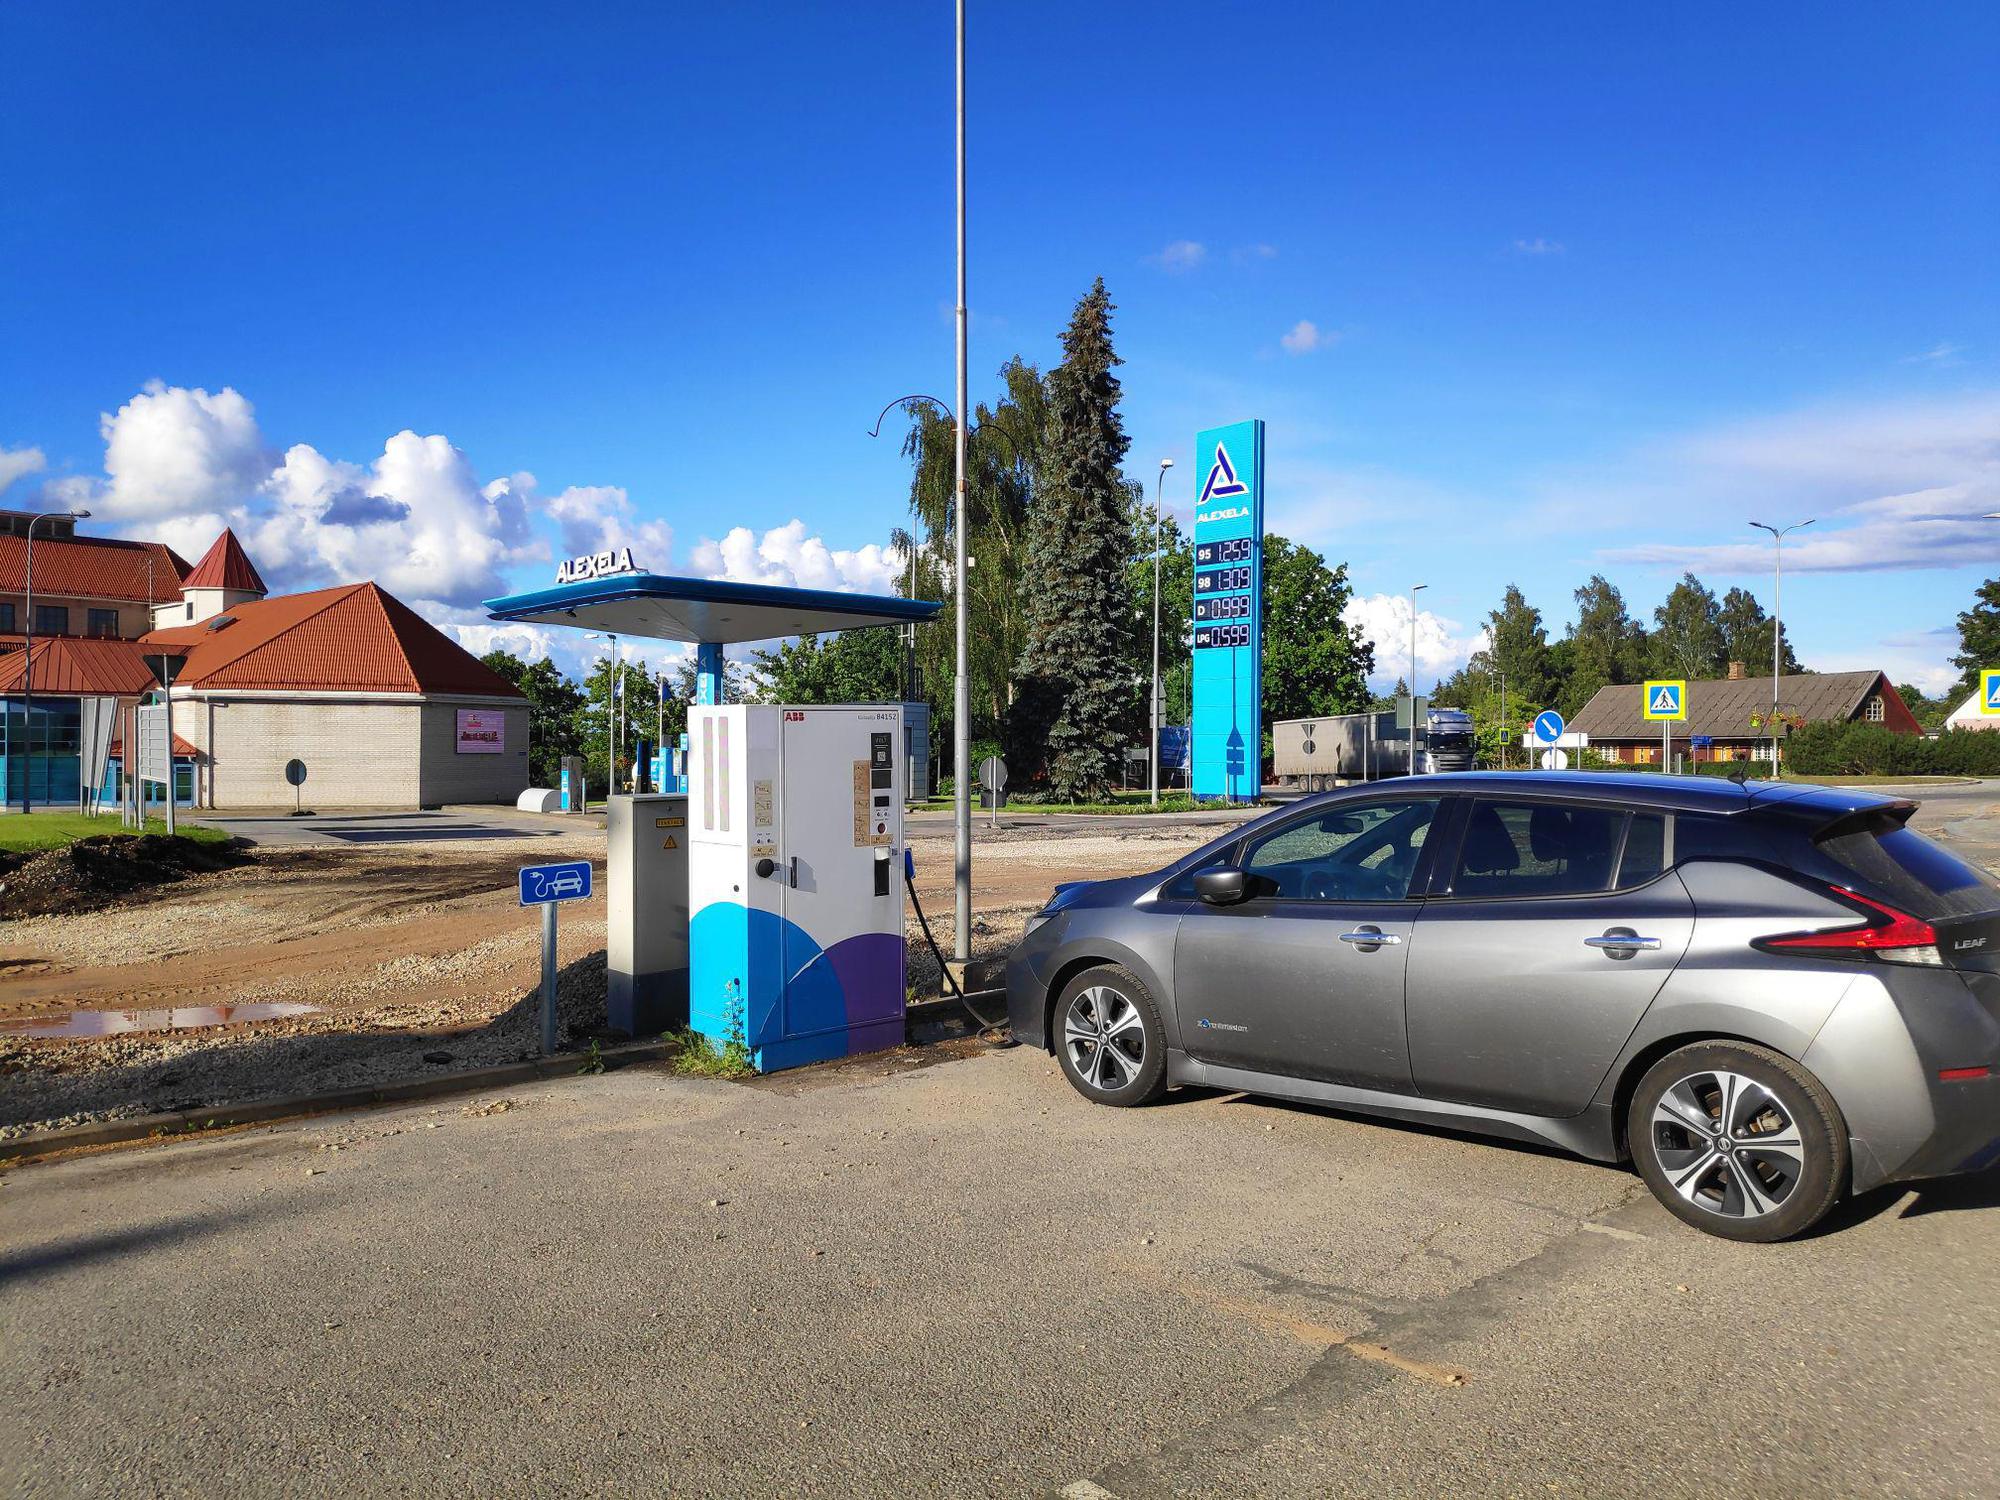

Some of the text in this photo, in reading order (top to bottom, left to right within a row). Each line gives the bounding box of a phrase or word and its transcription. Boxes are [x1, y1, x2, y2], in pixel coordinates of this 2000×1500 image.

[1197, 507, 1249, 523] ALEXELA
[1198, 539, 1250, 562] 95 1.259
[556, 547, 633, 583] ALEXELA
[1198, 567, 1250, 590] 98 1.309
[1197, 596, 1249, 619] D 0.999
[1197, 625, 1249, 647] LPG 0.599
[785, 712, 805, 721] ABB
[876, 713, 897, 721] 84152
[1954, 937, 1987, 949] LEAF
